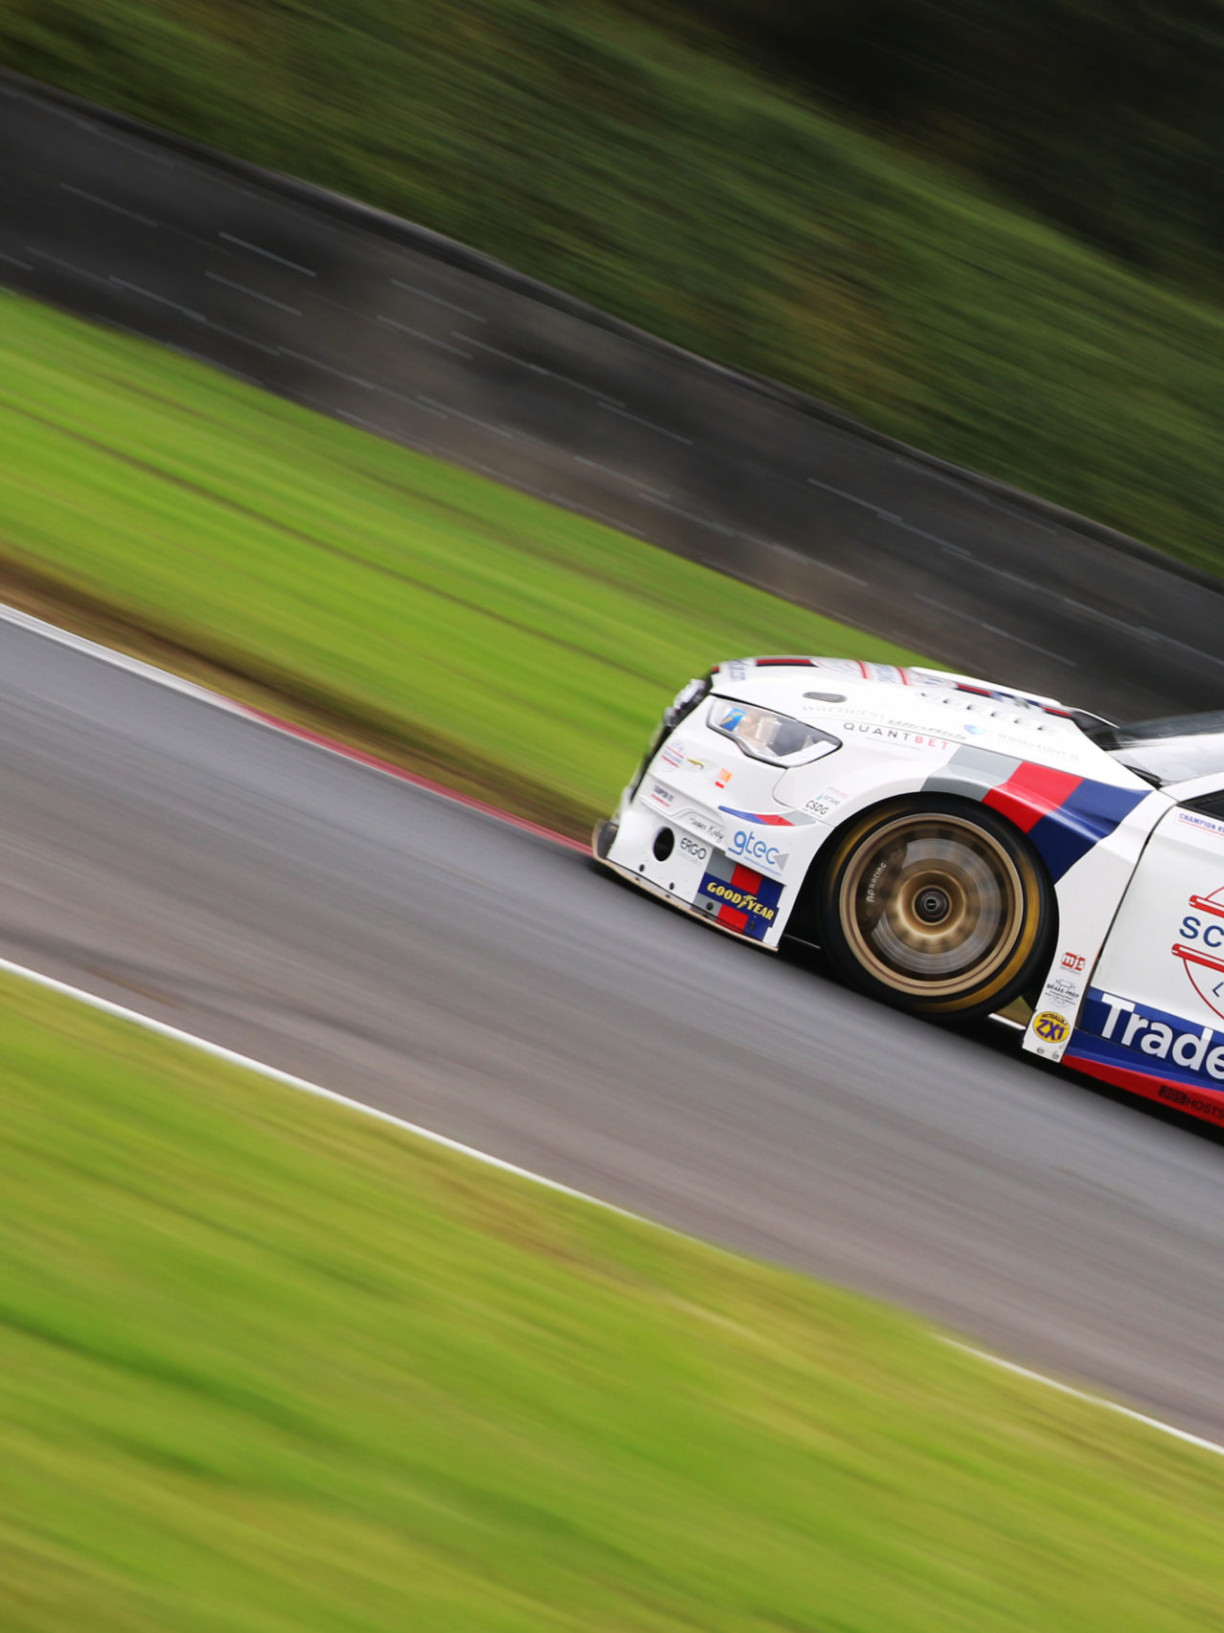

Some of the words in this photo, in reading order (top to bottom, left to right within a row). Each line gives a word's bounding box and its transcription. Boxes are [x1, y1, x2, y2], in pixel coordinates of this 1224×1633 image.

[843, 722, 949, 750] QUANTBET
[805, 800, 830, 816] CSDG
[680, 837, 707, 860] ERGO
[728, 831, 780, 865] gtec
[707, 882, 775, 920] GOODYEAR
